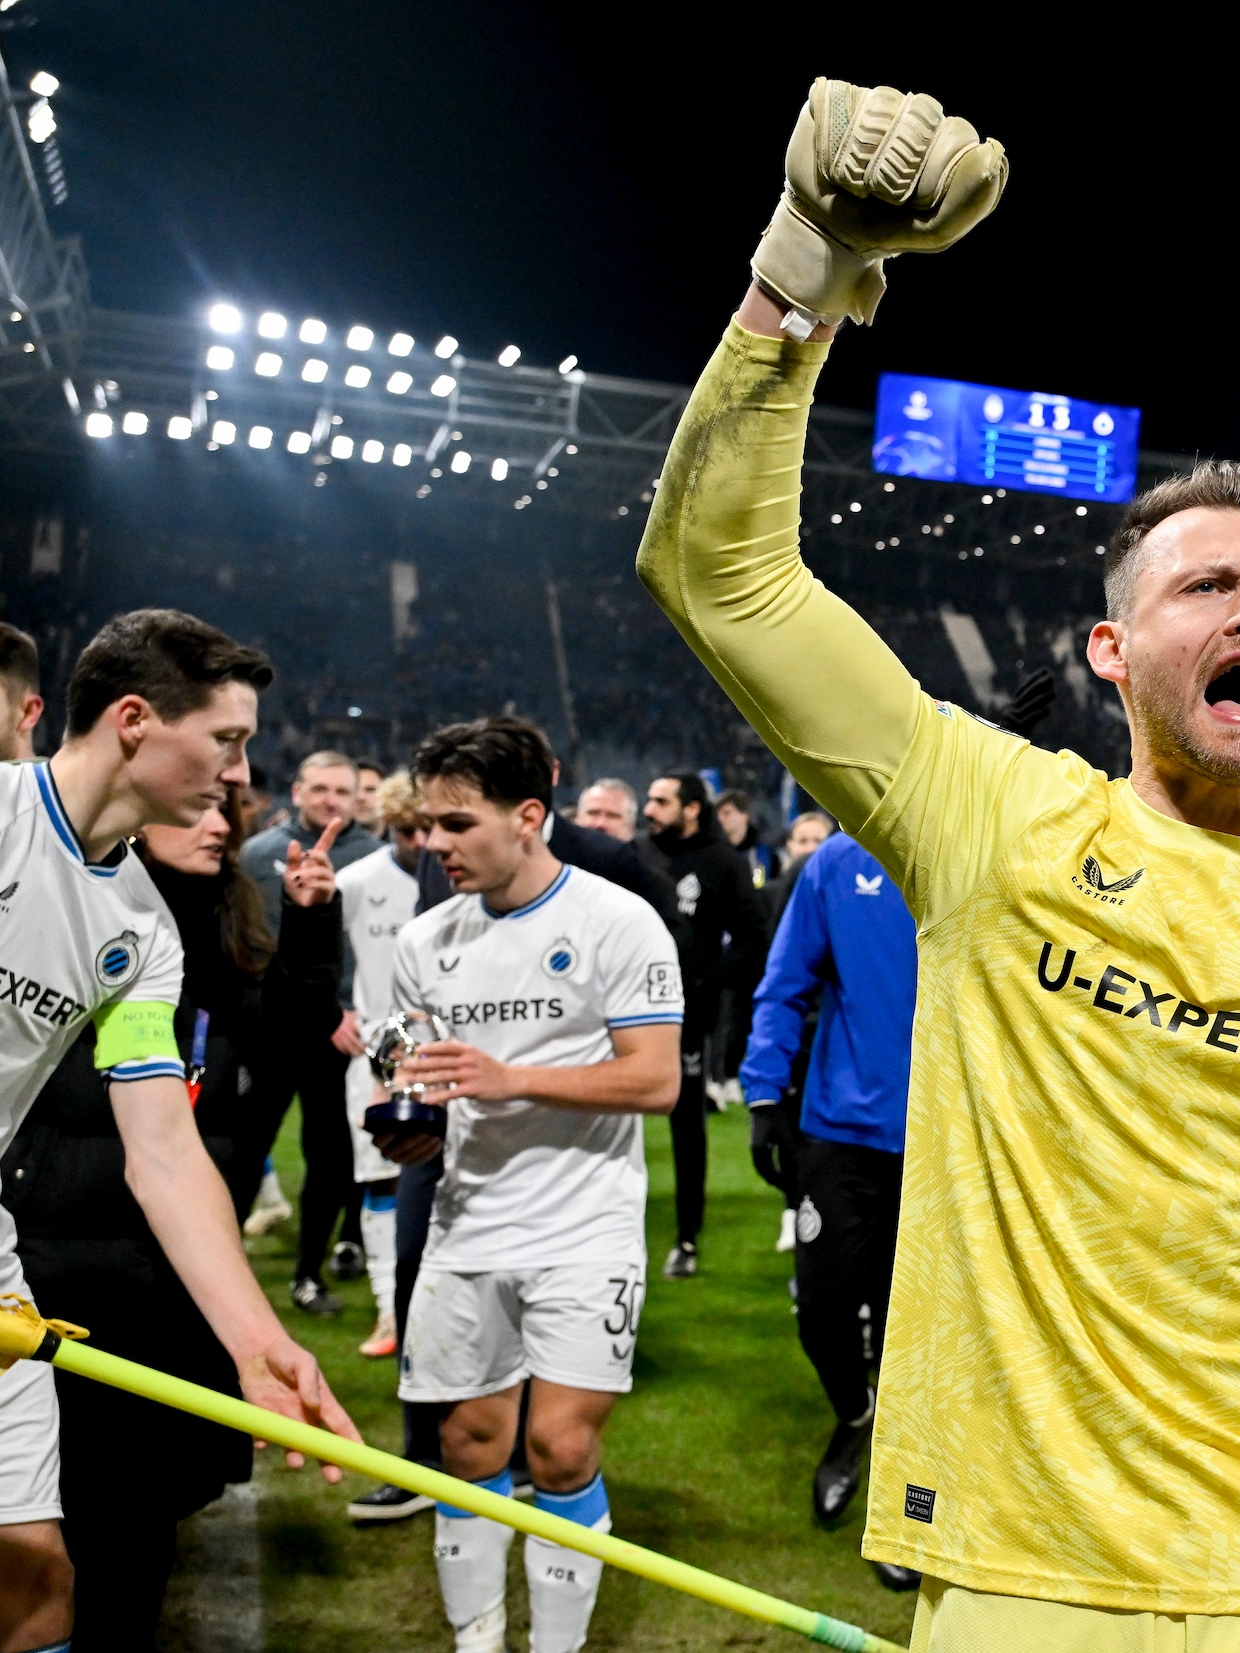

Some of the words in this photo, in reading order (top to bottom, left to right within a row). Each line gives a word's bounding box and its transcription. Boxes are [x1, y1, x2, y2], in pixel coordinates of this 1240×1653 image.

[1071, 876, 1126, 906] CASTORE
[0, 966, 87, 1025] XPERT
[604, 1278, 643, 1336] 30
